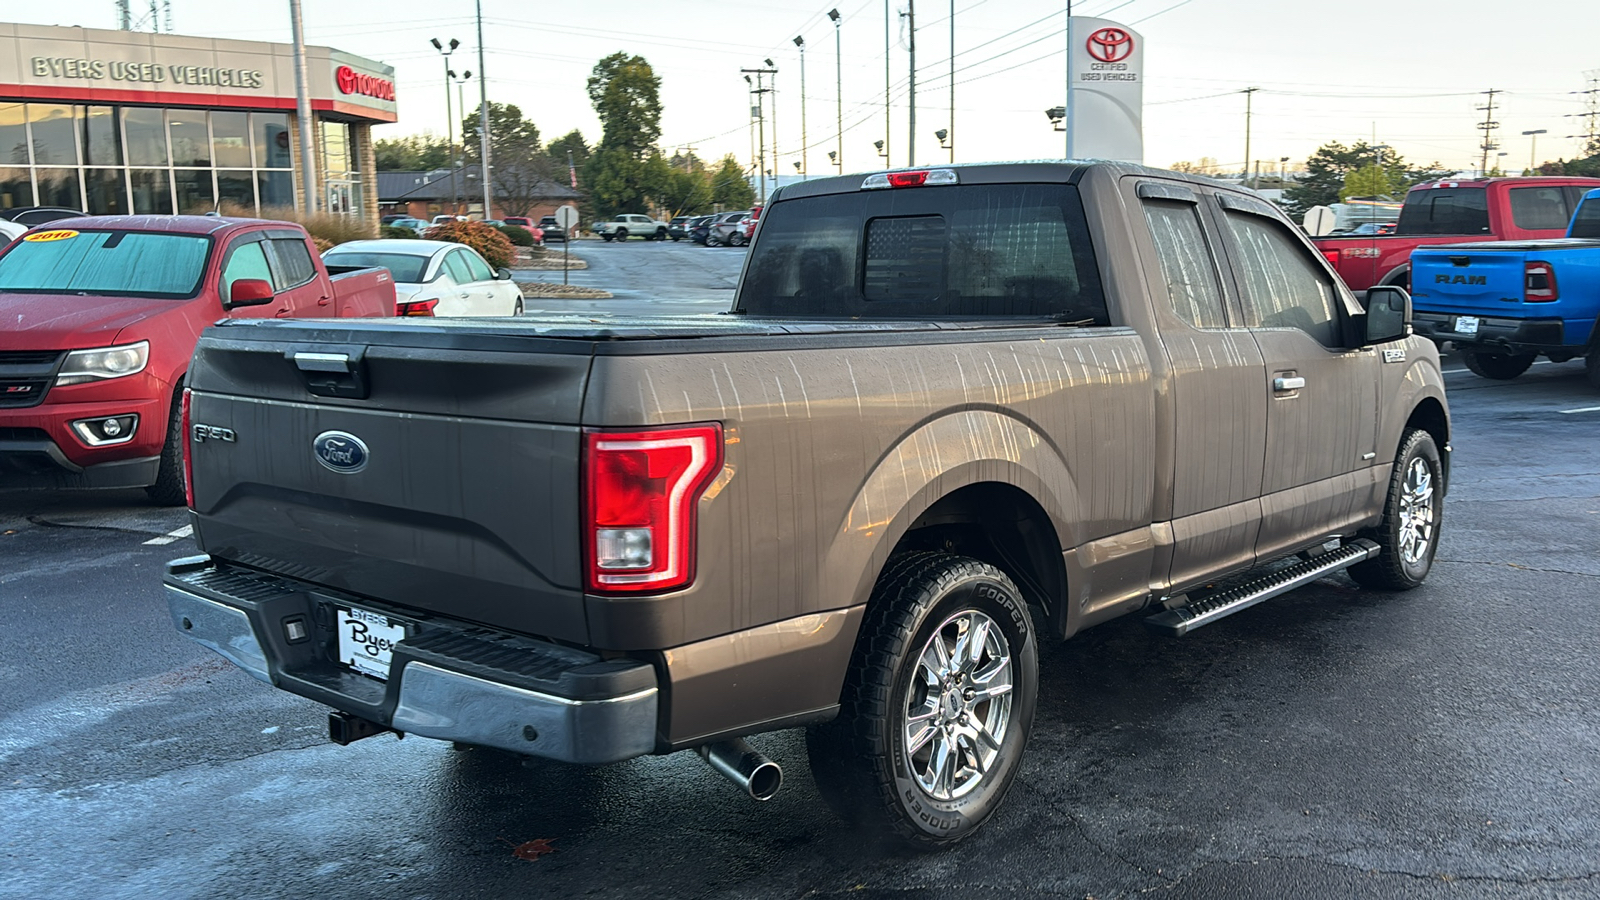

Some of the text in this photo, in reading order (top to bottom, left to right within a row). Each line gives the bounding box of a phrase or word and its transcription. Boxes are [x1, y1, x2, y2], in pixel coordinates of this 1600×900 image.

[32, 56, 264, 89] BYERS USED VEHICLES
[1081, 73, 1137, 81] USED VEHICLES
[1091, 63, 1128, 71] CERTIFIED
[353, 72, 396, 102] TOYOTA
[29, 231, 74, 241] 2016
[1435, 274, 1487, 285] RAM
[323, 439, 354, 464] Ford
[978, 586, 1026, 634] COOPER
[344, 619, 396, 656] Byer
[904, 788, 960, 830] COOPER
